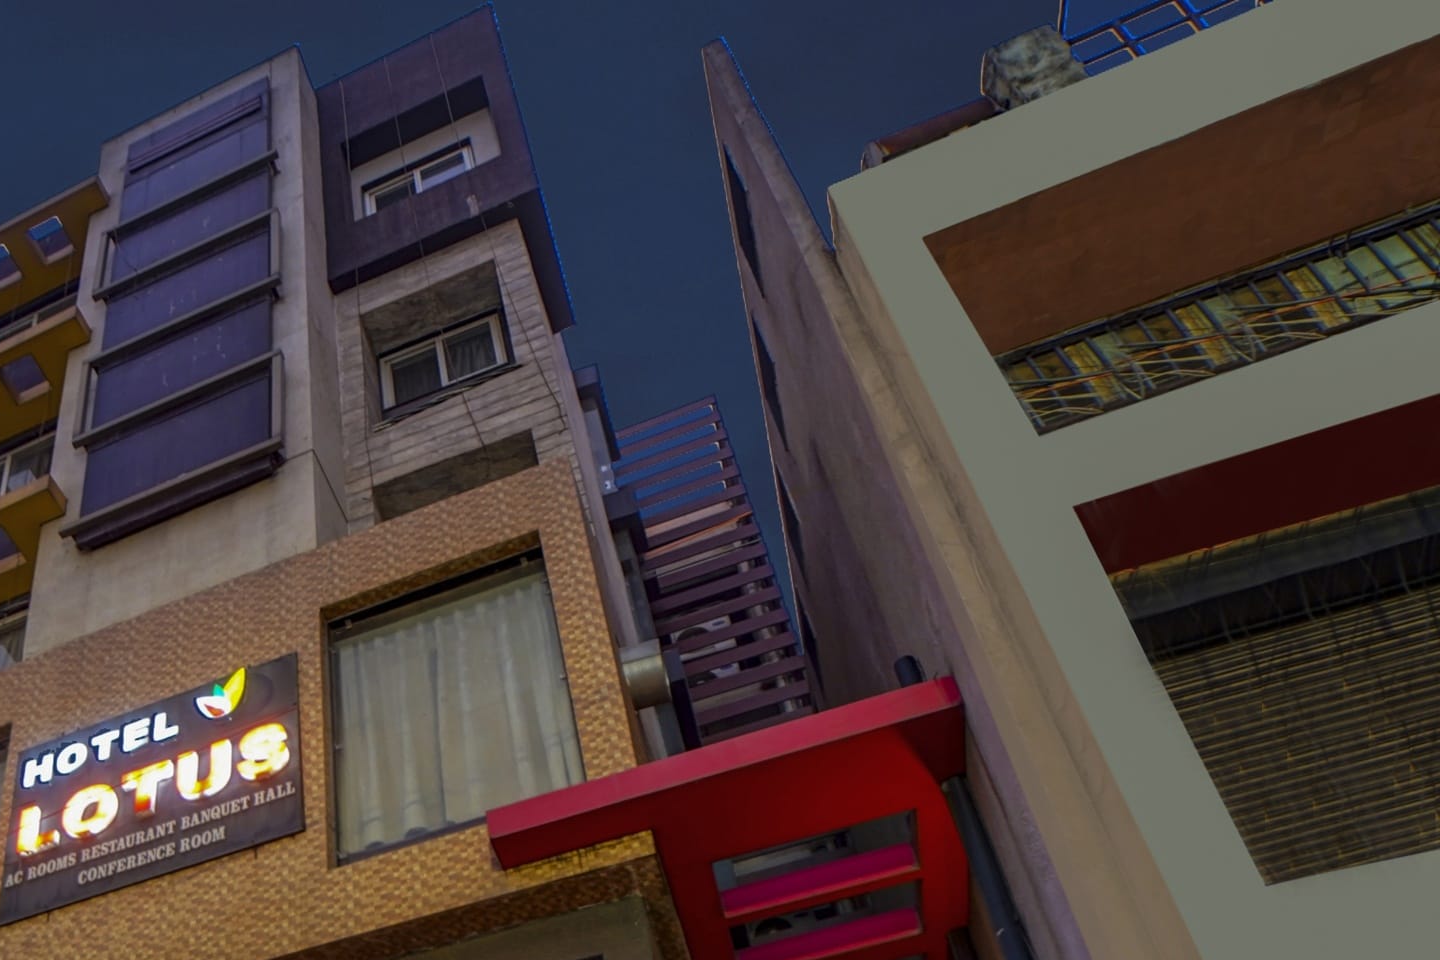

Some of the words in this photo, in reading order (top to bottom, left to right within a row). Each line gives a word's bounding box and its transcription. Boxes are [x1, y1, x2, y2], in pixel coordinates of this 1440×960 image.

[16, 723, 290, 857] LOTUS
[23, 712, 179, 788] HOTEL
[5, 870, 23, 889] AC
[28, 852, 78, 881] ROOMS
[81, 819, 177, 863] RESTAURANT
[181, 795, 252, 831] BANQUET
[254, 781, 296, 807] HALL
[78, 843, 176, 885] CONFERENCE
[180, 826, 226, 853] ROOM
